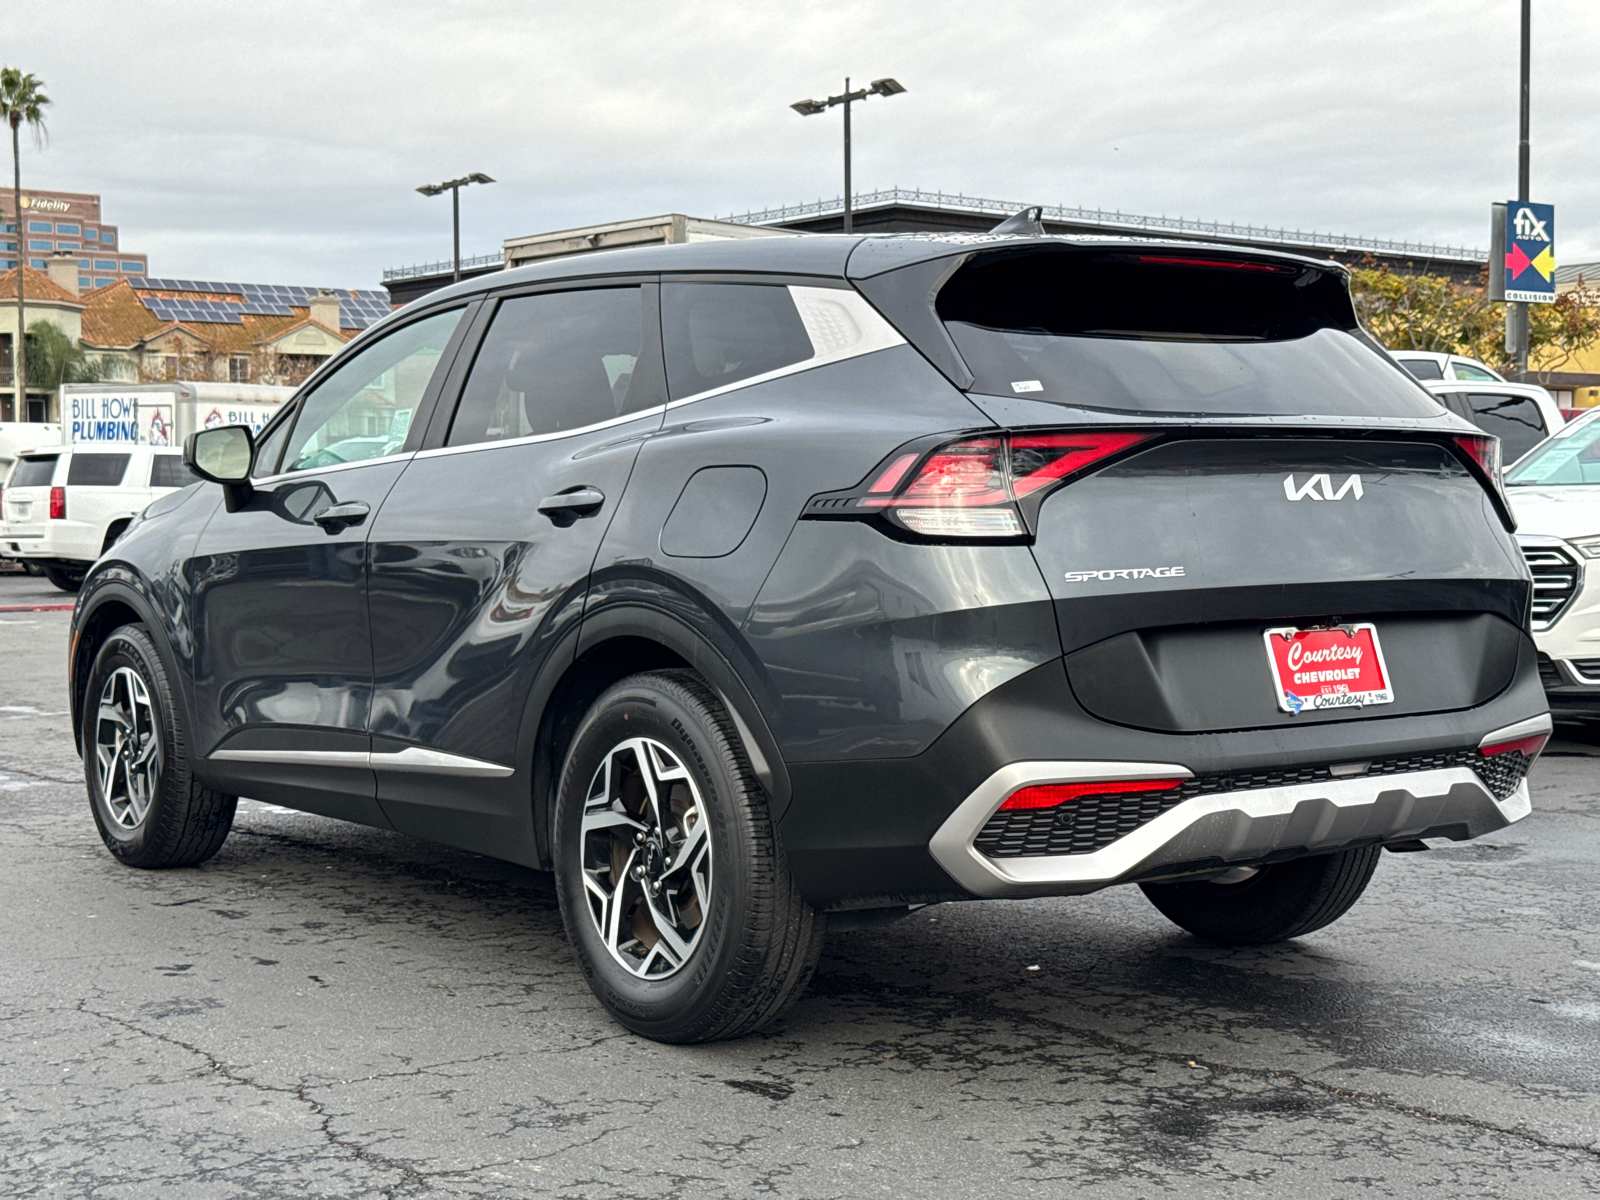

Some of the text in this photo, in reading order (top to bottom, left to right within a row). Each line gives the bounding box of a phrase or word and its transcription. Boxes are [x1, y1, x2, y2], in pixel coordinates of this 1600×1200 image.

[30, 199, 70, 212] Fidelity
[1515, 234, 1542, 242] AUTO
[1506, 292, 1554, 302] COLLISION
[72, 398, 97, 419] BILL
[228, 411, 256, 424] BILL
[72, 421, 139, 441] PLUMBING
[1283, 473, 1364, 501] KIA
[1064, 566, 1186, 583] SPORTAGE
[1287, 641, 1363, 671] Courtesy
[1293, 667, 1360, 685] CHEVROLET
[1333, 684, 1350, 694] 1961
[1313, 693, 1366, 710] Courtesy
[670, 717, 719, 803] Dynapro
